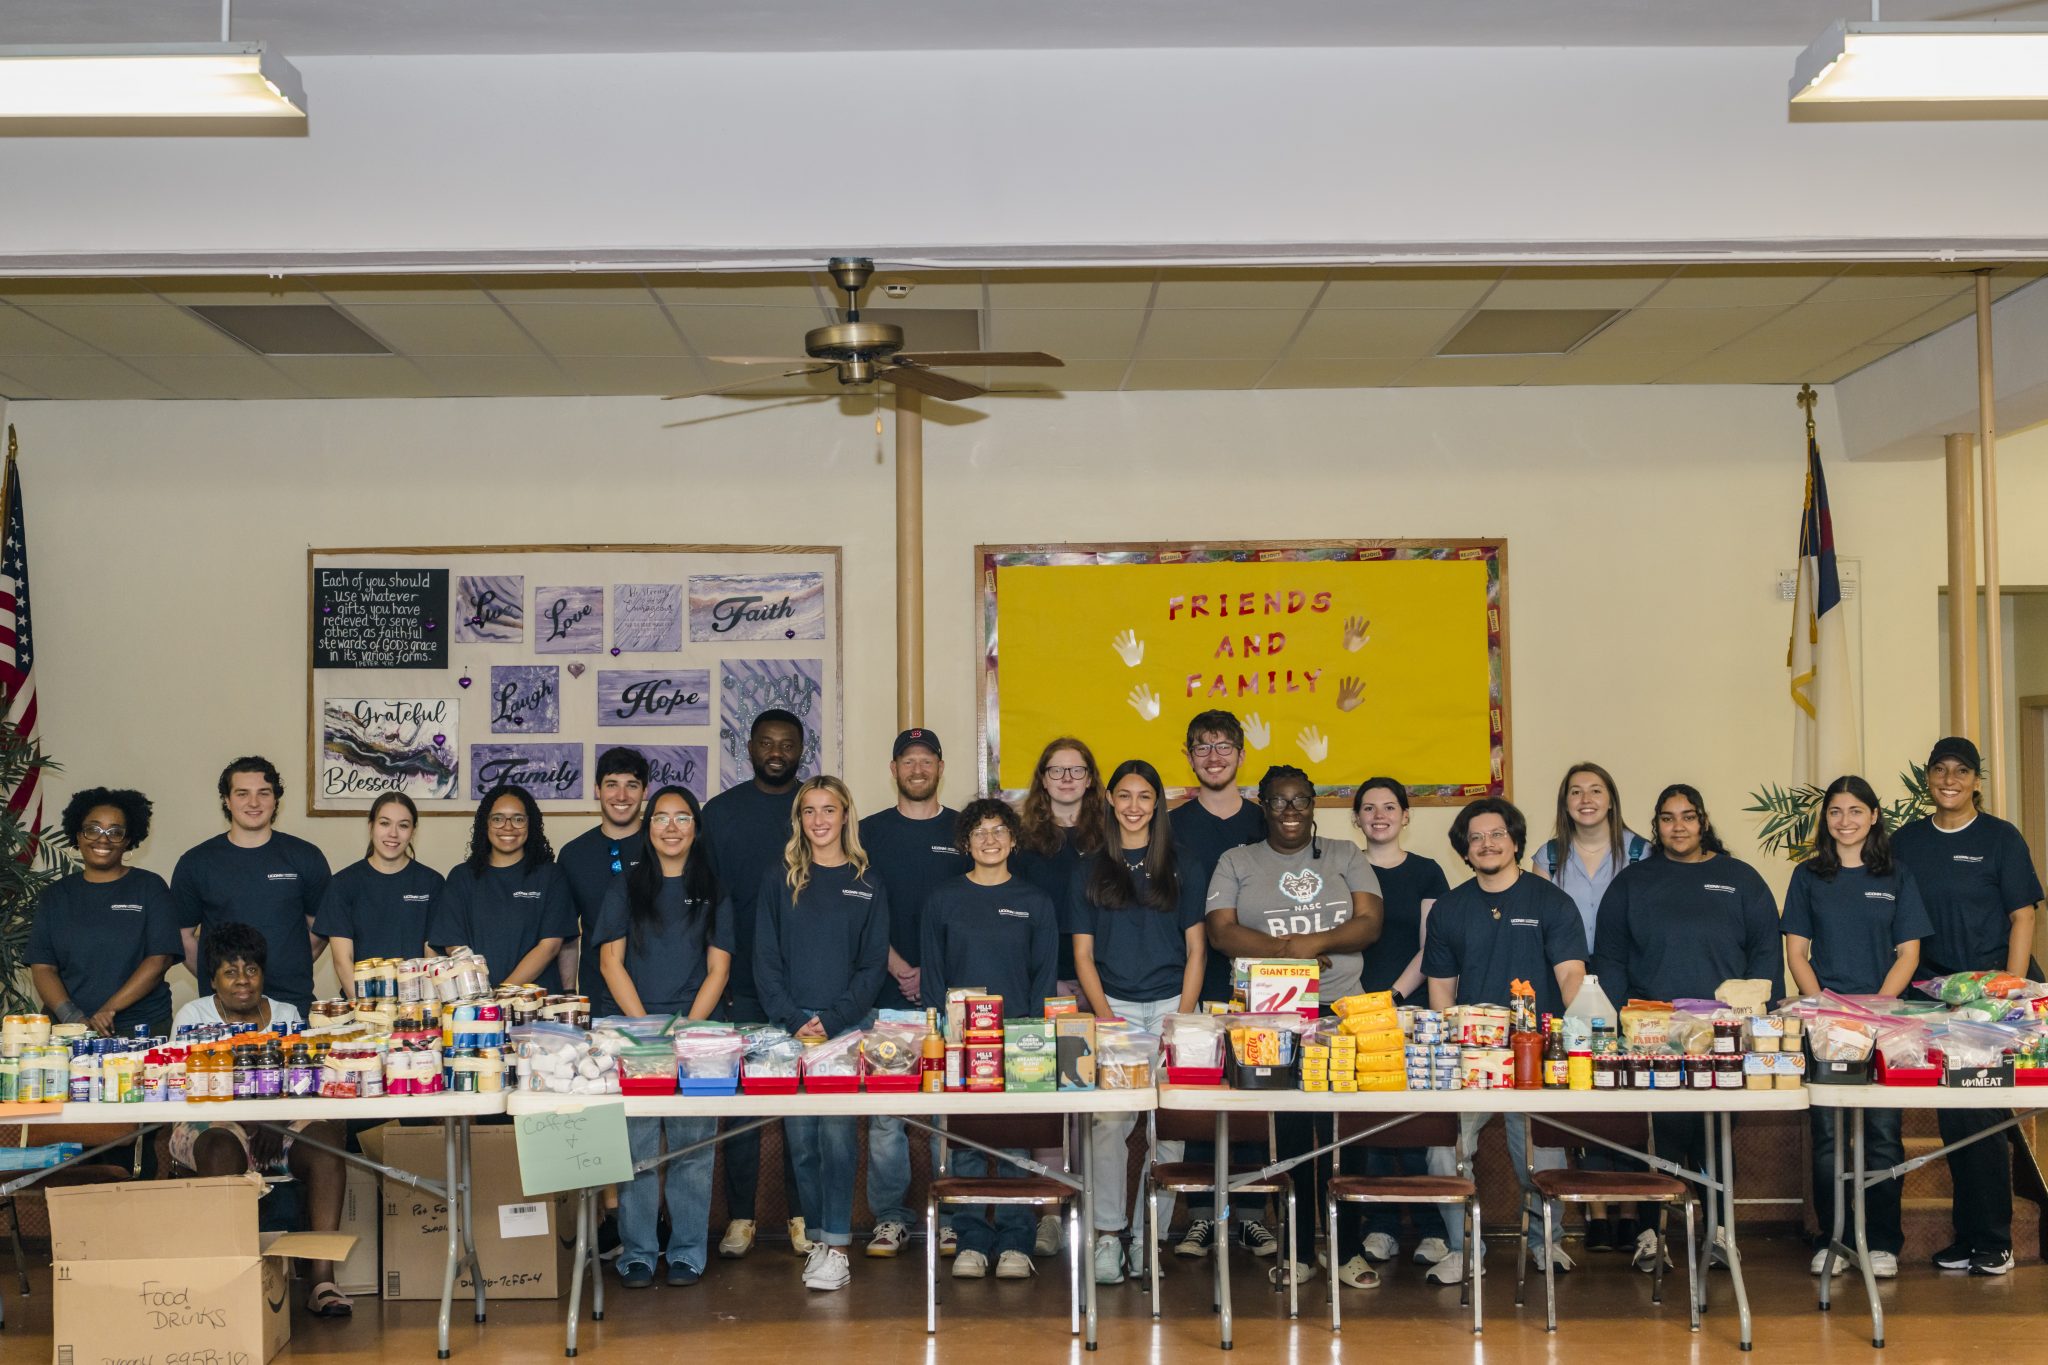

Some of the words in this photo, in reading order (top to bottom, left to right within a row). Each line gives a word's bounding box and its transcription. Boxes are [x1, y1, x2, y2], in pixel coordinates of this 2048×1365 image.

[322, 571, 349, 587] Each
[352, 571, 363, 591] of
[366, 578, 387, 592] you
[388, 571, 430, 588] should
[361, 588, 419, 602] whatever
[1169, 590, 1332, 620] FRIENDS
[323, 614, 370, 626] recieved
[375, 614, 387, 627] to
[389, 617, 418, 627] serve
[337, 602, 366, 619] gifts
[370, 605, 391, 619] you
[392, 602, 420, 615] have
[544, 598, 592, 642] Love
[711, 595, 796, 633] Faith
[325, 626, 362, 640] others,
[363, 628, 376, 638] as
[379, 626, 422, 639] faithful
[370, 638, 381, 652] of
[410, 641, 437, 652] grace
[330, 651, 339, 661] in
[344, 649, 357, 661] it's
[362, 651, 394, 661] various
[396, 650, 432, 664] forms.
[1214, 632, 1286, 659] AND
[1186, 668, 1322, 697] FAMILY
[492, 680, 553, 724] Laugh
[616, 679, 699, 719] Hope
[354, 700, 447, 729] Grateful
[323, 766, 409, 795] Blessed
[476, 758, 579, 795] Family
[648, 758, 696, 784] kful
[1294, 902, 1322, 911] NASC
[1260, 968, 1289, 976] GIANT
[1291, 968, 1311, 976] SIZE
[1246, 1037, 1261, 1066] veeta
[1962, 1077, 2003, 1087] unMEAT
[523, 1113, 587, 1135] Coffee
[566, 1151, 602, 1170] Tea
[412, 1204, 427, 1216] Pet
[139, 1280, 189, 1306] Food
